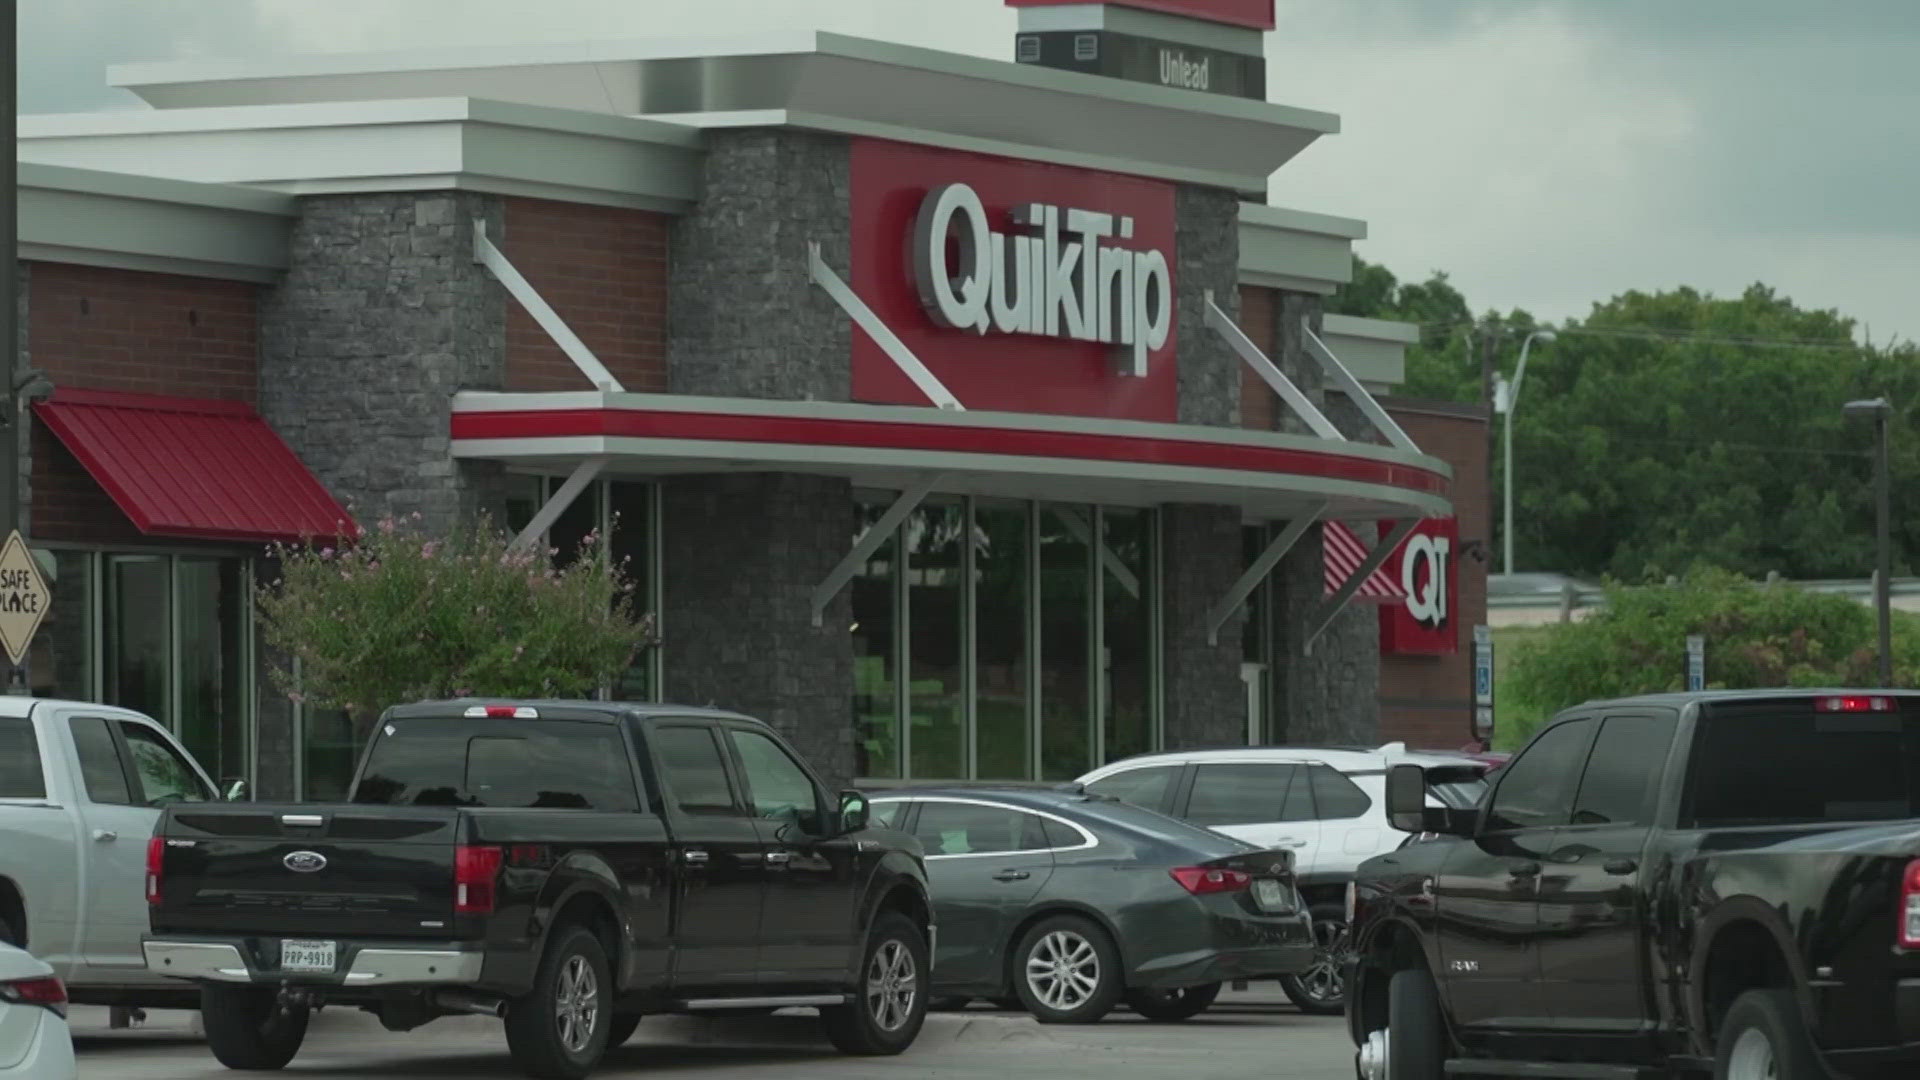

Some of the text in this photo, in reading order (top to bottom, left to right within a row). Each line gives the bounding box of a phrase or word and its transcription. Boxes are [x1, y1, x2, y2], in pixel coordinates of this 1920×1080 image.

[1159, 49, 1209, 90] Unlead
[927, 182, 1172, 377] QuikTrip
[1, 569, 30, 590] SAFE
[1402, 532, 1450, 627] QT
